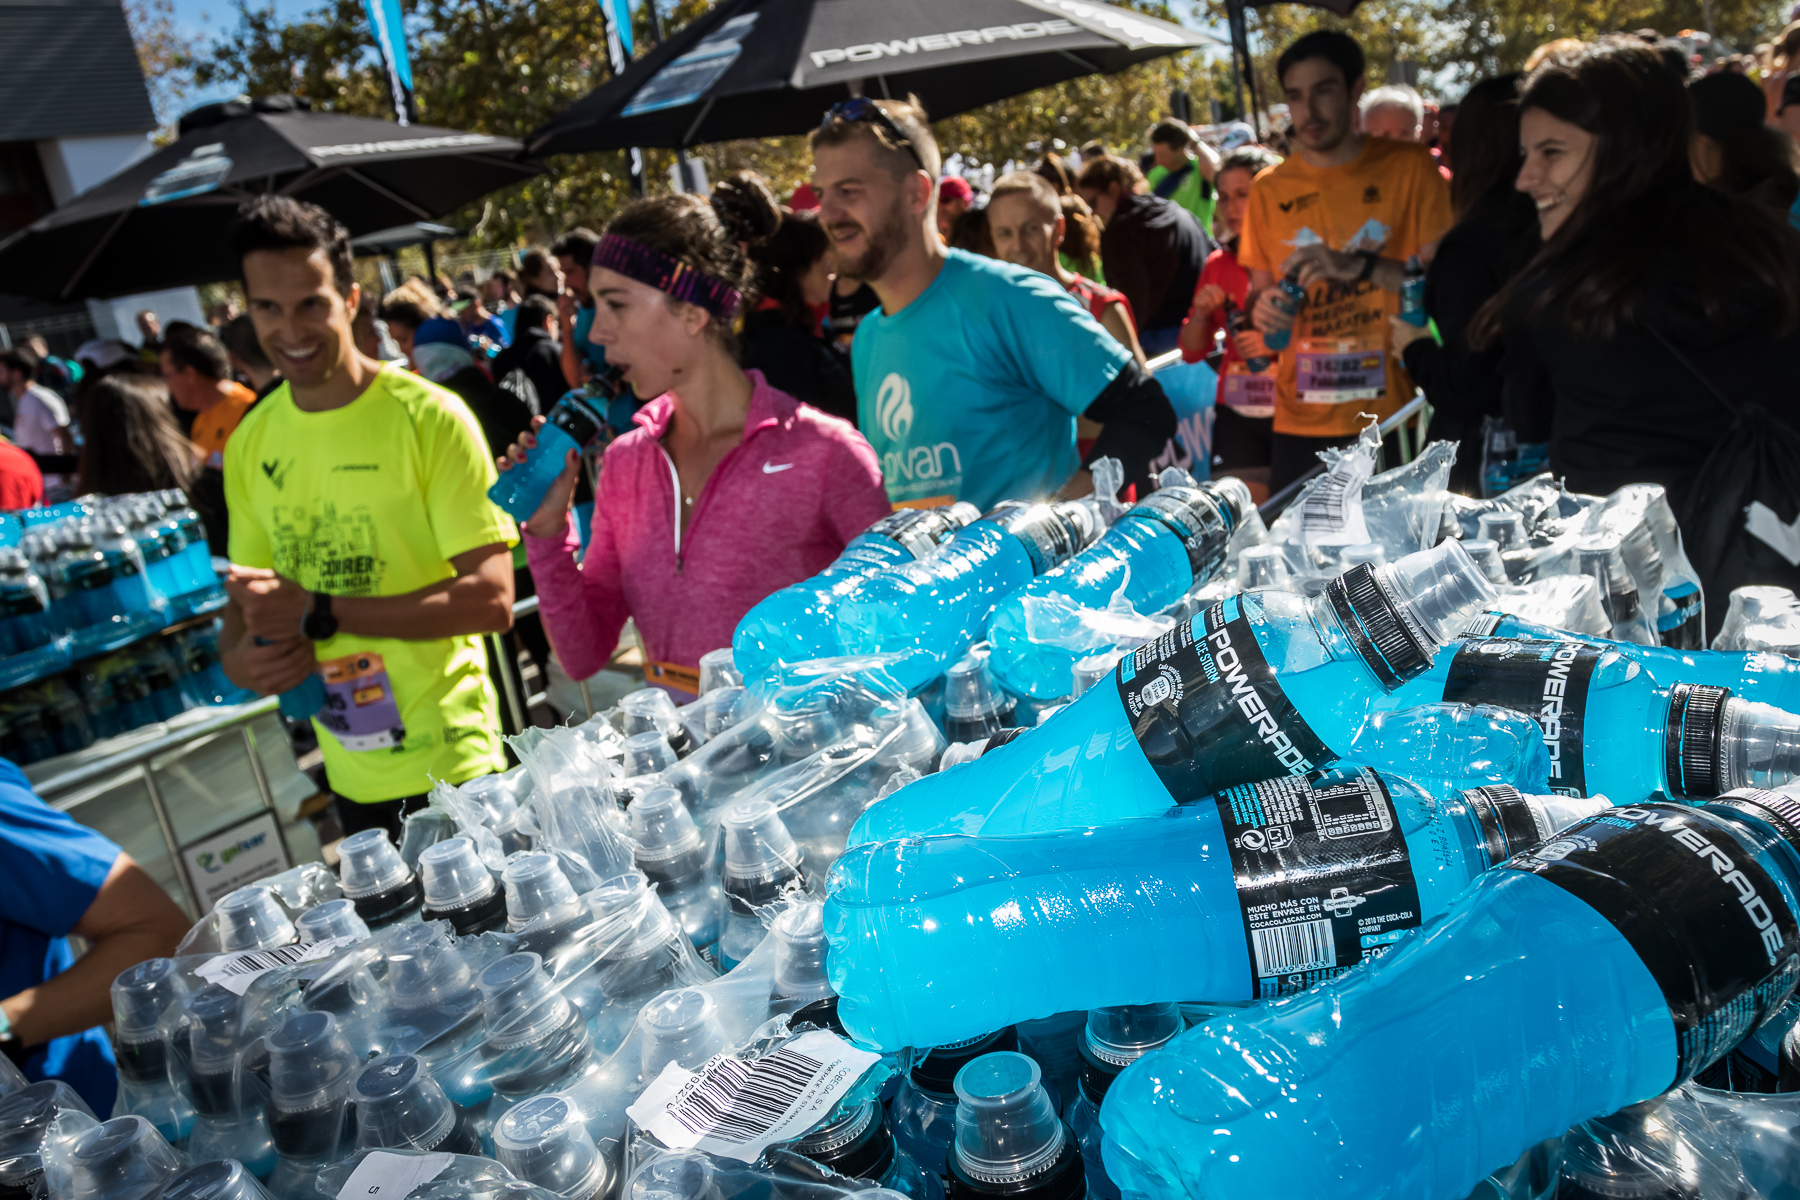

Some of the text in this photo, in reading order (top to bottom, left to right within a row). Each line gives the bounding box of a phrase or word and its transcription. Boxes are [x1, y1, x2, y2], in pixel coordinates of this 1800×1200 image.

[809, 18, 1074, 69] POWERADE
[1195, 640, 1209, 657] ICE
[1200, 652, 1221, 685] STORM
[1207, 628, 1315, 775] POWERADE
[1599, 816, 1638, 830] STORM
[1603, 806, 1785, 959] POWERADE
[1247, 897, 1319, 914] MUCHO MÁS CON
[1249, 904, 1321, 922] ESTE ENVASE EN
[1250, 913, 1322, 929] COCACOLASCAN.COM
[1365, 917, 1377, 926] 2010
[1377, 915, 1386, 924] THE
[1386, 911, 1414, 922] COCA-COLA
[1359, 925, 1381, 934] COMPANY
[1269, 960, 1327, 976] 5449 2653
[814, 1058, 842, 1091] POWERADE
[818, 1067, 850, 1098] COBEGA,
[806, 1088, 816, 1101] ICE
[788, 1100, 808, 1121] STORM
